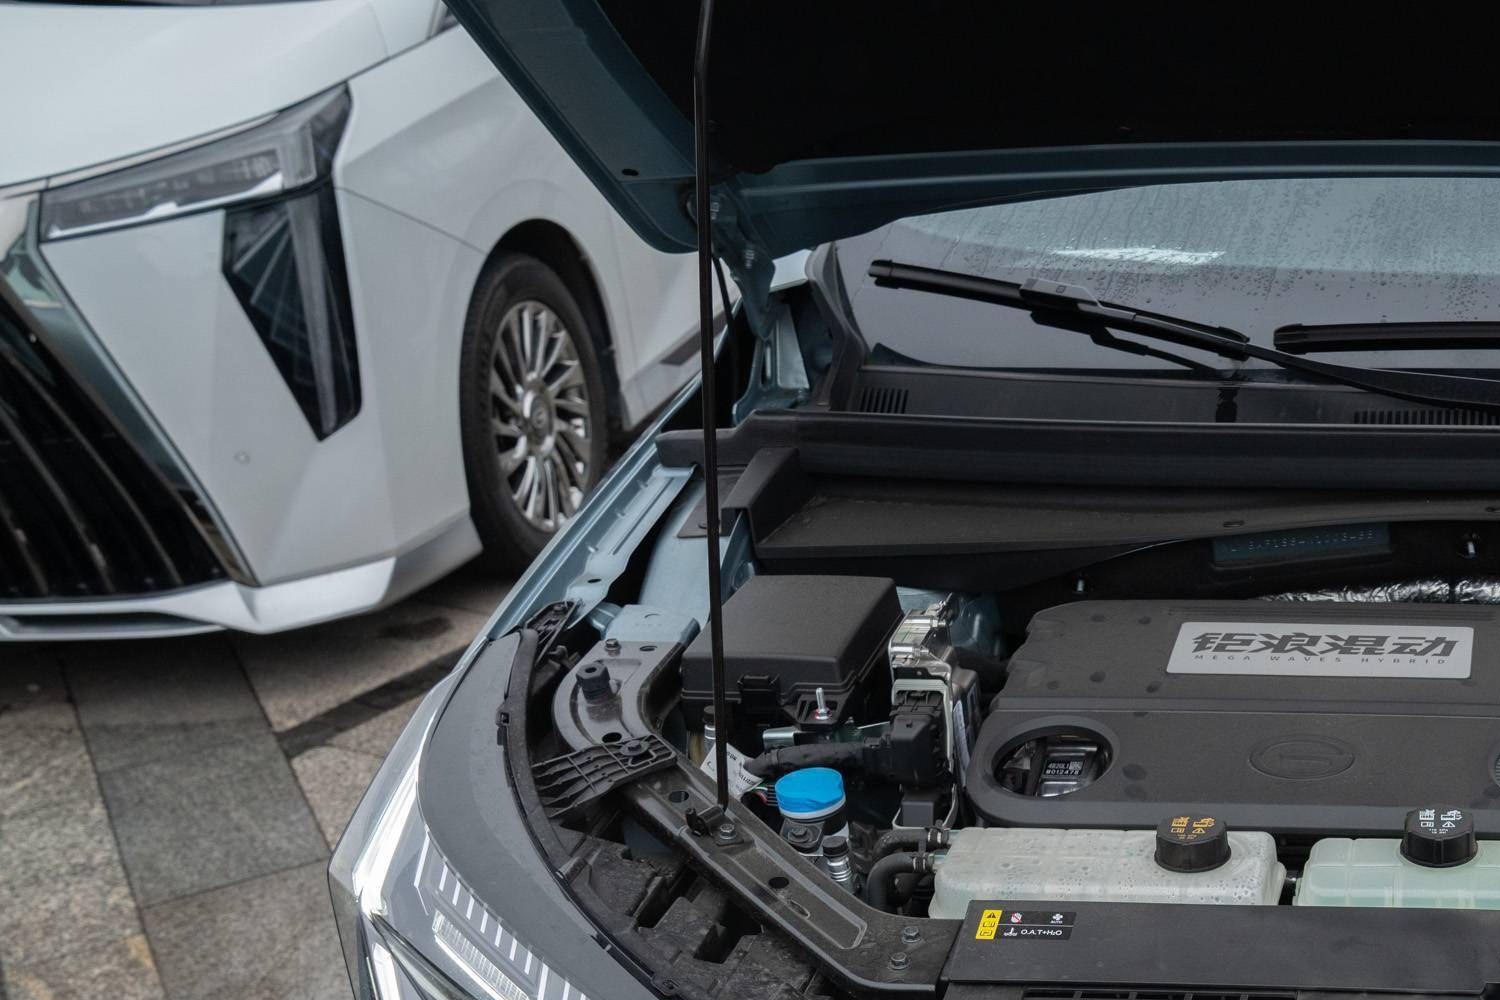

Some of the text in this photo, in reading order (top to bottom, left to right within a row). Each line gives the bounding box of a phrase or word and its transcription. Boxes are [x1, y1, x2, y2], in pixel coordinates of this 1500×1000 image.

[1192, 632, 1459, 657] 钜浪混动
[1193, 654, 1446, 665] MEGA WAVES HYBRID
